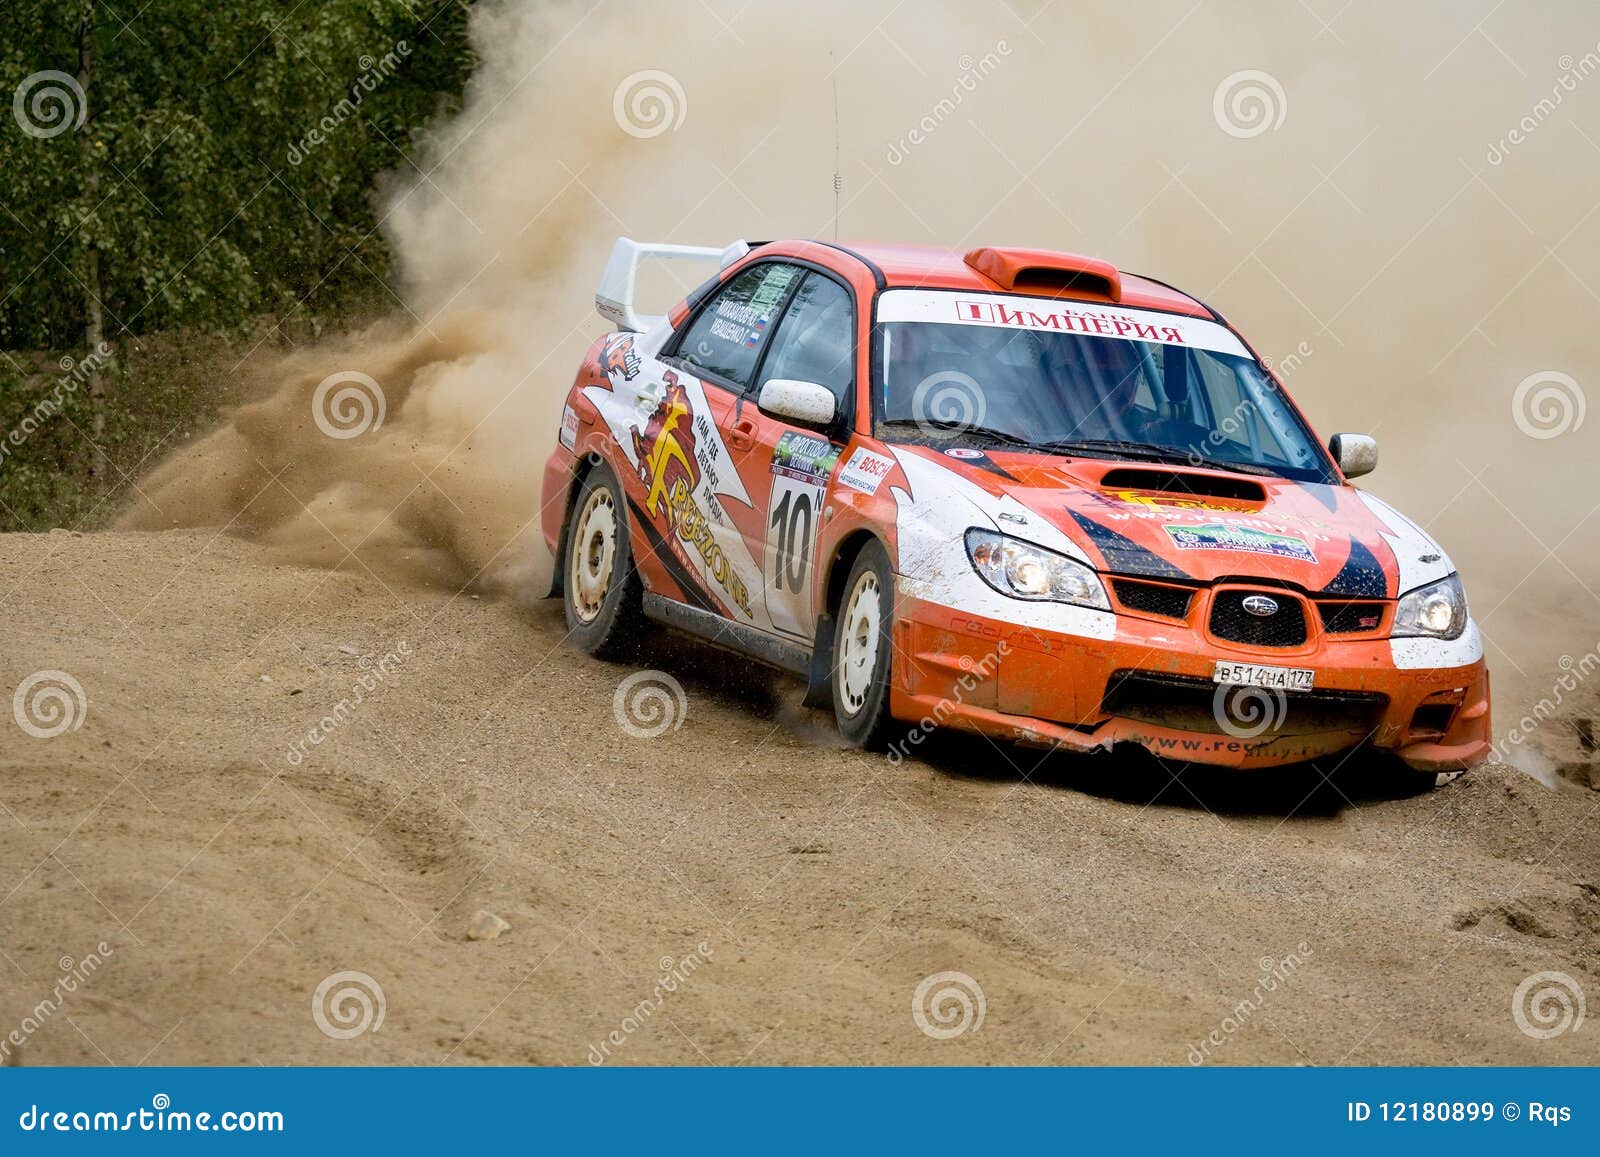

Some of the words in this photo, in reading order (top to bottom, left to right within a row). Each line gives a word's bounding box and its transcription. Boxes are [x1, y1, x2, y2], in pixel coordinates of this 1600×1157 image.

[995, 303, 1184, 343] ИМПЕРИЯ
[859, 456, 892, 479] BOSCH
[771, 489, 812, 595] 10
[814, 489, 825, 512] N
